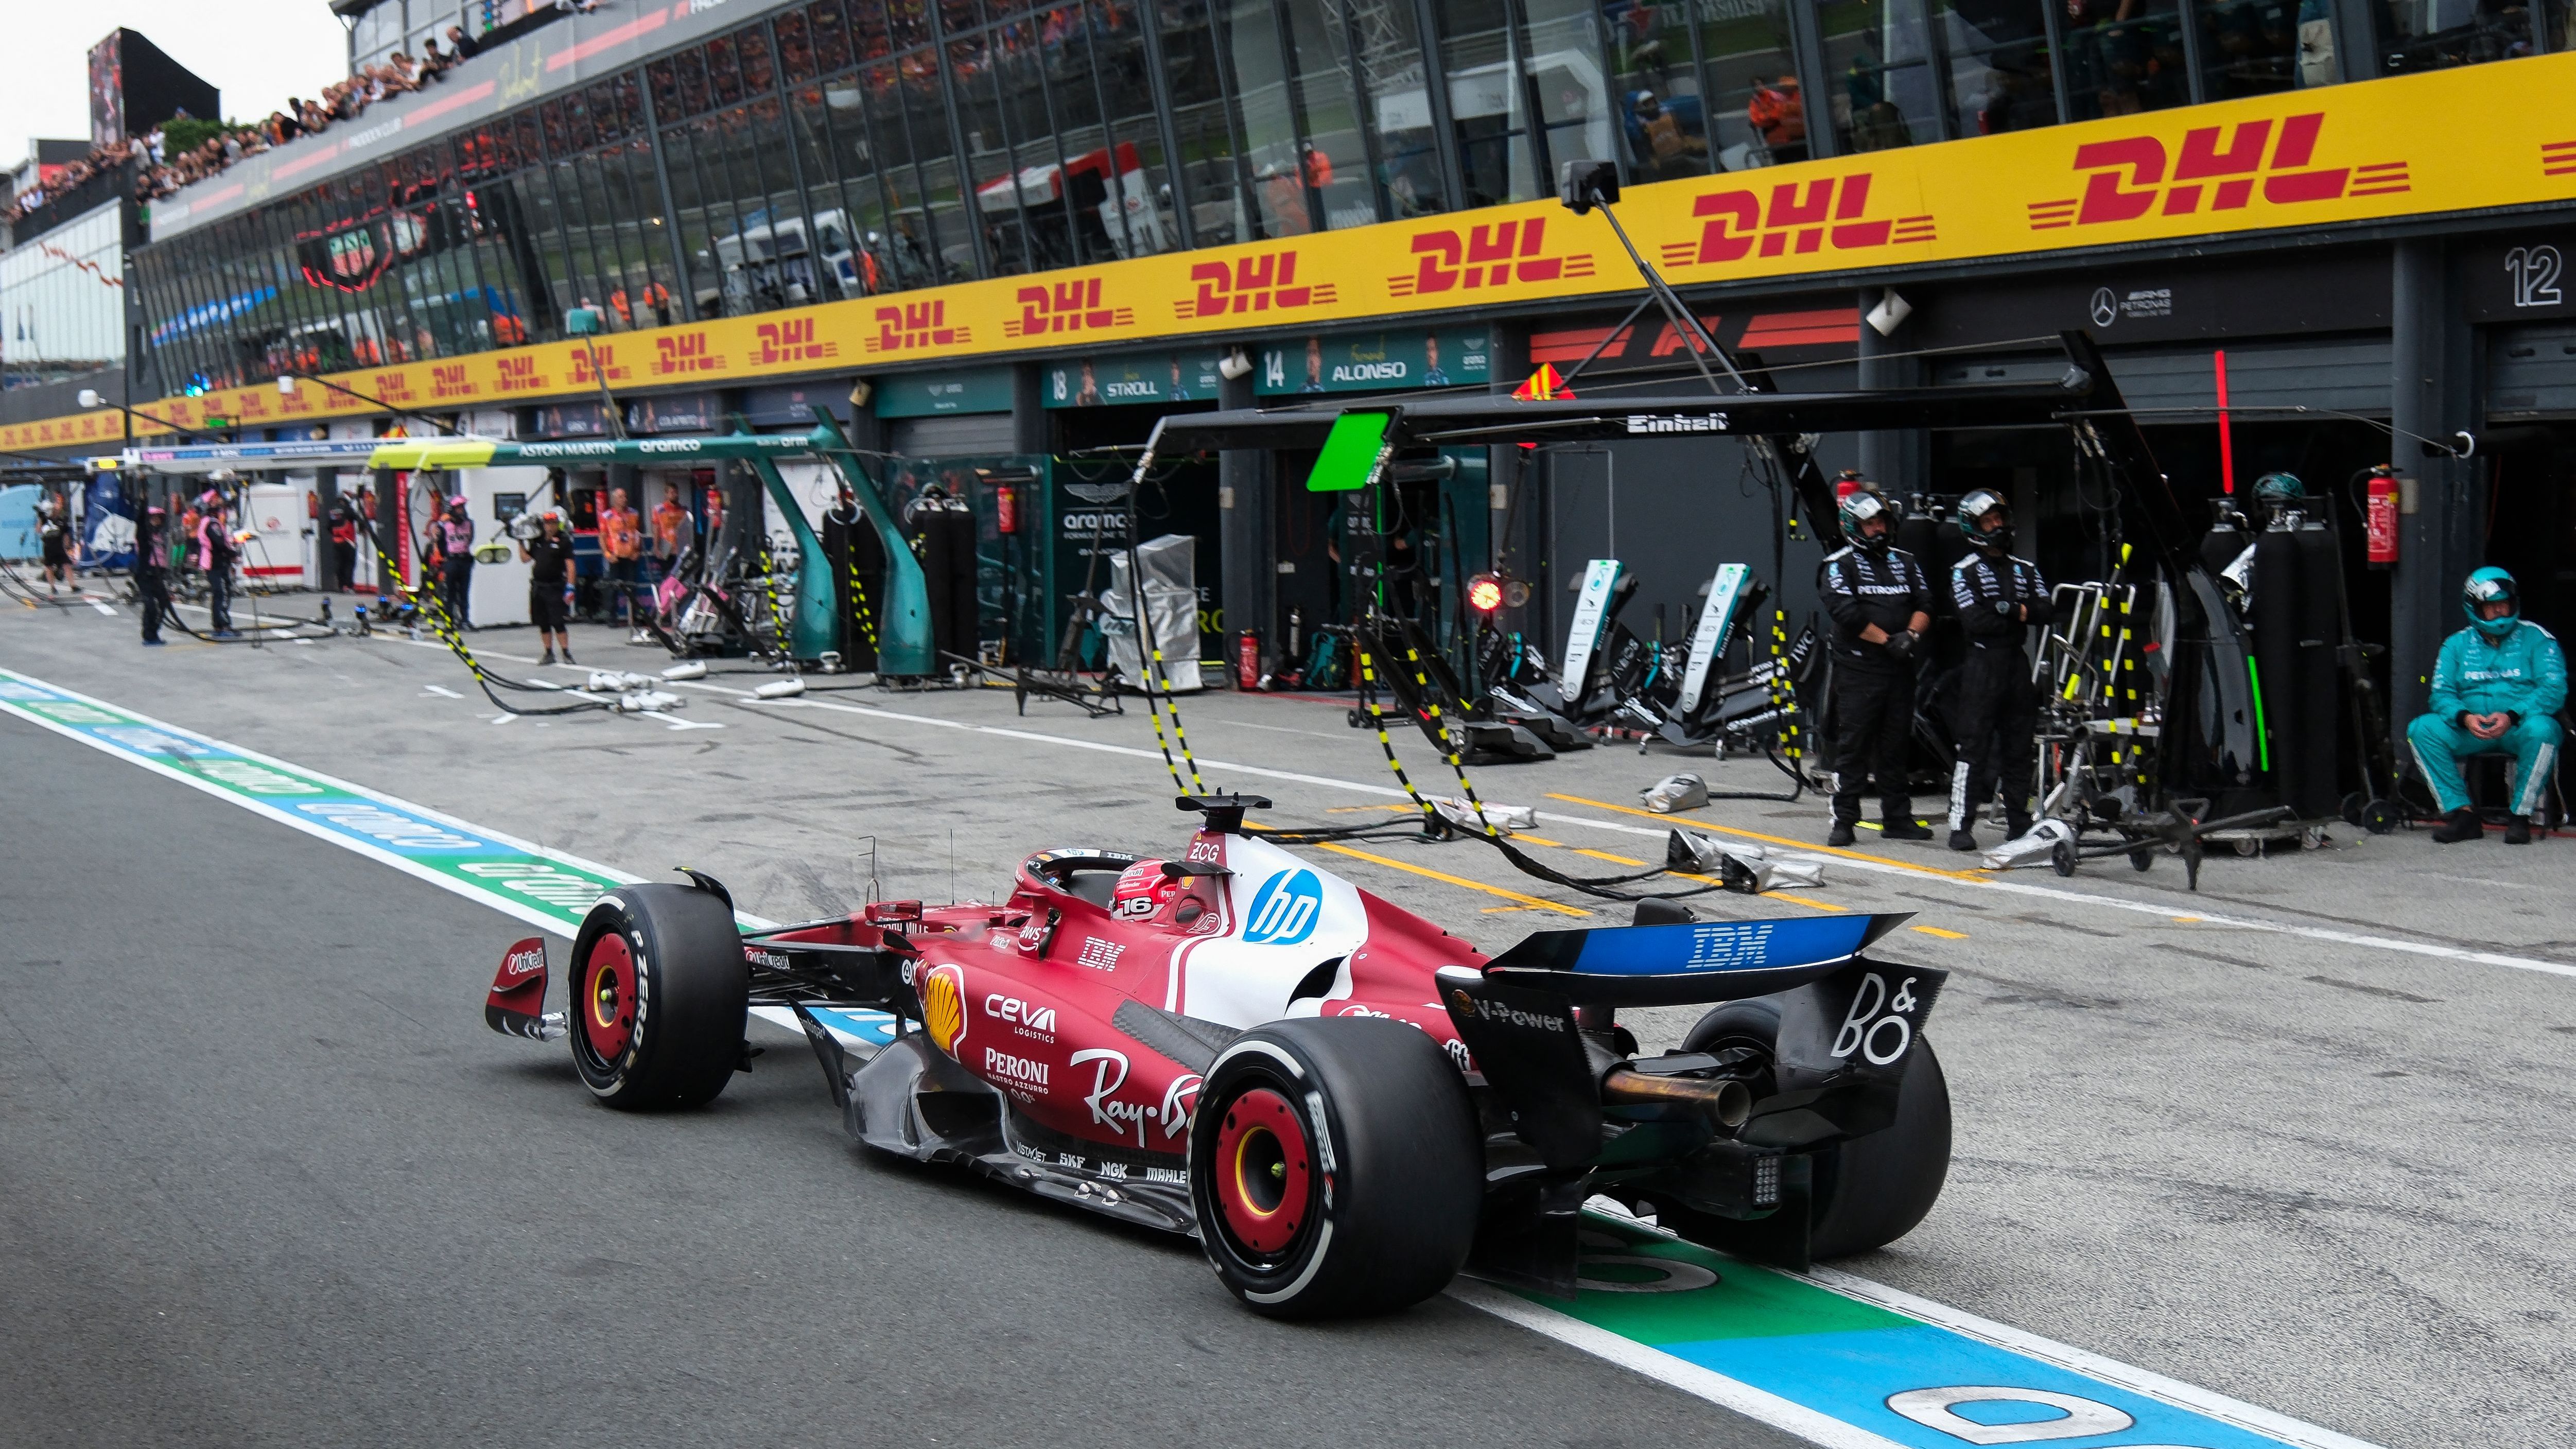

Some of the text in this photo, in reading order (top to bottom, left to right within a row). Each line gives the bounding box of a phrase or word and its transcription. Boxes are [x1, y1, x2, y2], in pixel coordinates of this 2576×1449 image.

[2073, 113, 2351, 225] DHL
[1693, 173, 1892, 264] DHL
[1411, 217, 1562, 293] DHL
[1191, 251, 1311, 318] DHL
[2505, 246, 2562, 306] 12
[1017, 278, 1114, 335] DHL
[756, 318, 825, 364] DHL
[876, 300, 954, 351] DHL
[571, 345, 620, 382] DHL
[656, 333, 715, 374] DHL
[1264, 350, 1284, 387] 14
[432, 365, 472, 397] DHL
[498, 356, 541, 391] DHL
[1052, 371, 1067, 400] 18
[1332, 361, 1407, 381] ALONSO
[1107, 381, 1158, 397] STROLL
[519, 443, 563, 457] ASTON
[566, 441, 616, 455] MARTIN
[639, 439, 701, 453] aramco
[1857, 584, 1911, 595] PETRONAS
[1789, 629, 1816, 664] IWC
[1107, 852, 1133, 861] IBM
[1189, 842, 1220, 862] ZCG
[1120, 897, 1153, 915] 16
[1242, 869, 1322, 945] hp
[631, 930, 643, 948] P
[1019, 926, 1042, 941] aws
[1685, 925, 1773, 968] IBM
[1077, 935, 1126, 972] IBM
[1474, 999, 1564, 1033] V-Power
[1014, 1025, 1054, 1044] LOGISTICS
[985, 1046, 1049, 1085] PERONI
[987, 1072, 1049, 1095] NASTRO AZZURRO
[1059, 1152, 1086, 1168] SKF
[1100, 1161, 1128, 1179] NGK
[1145, 1167, 1187, 1184] MAHLE
